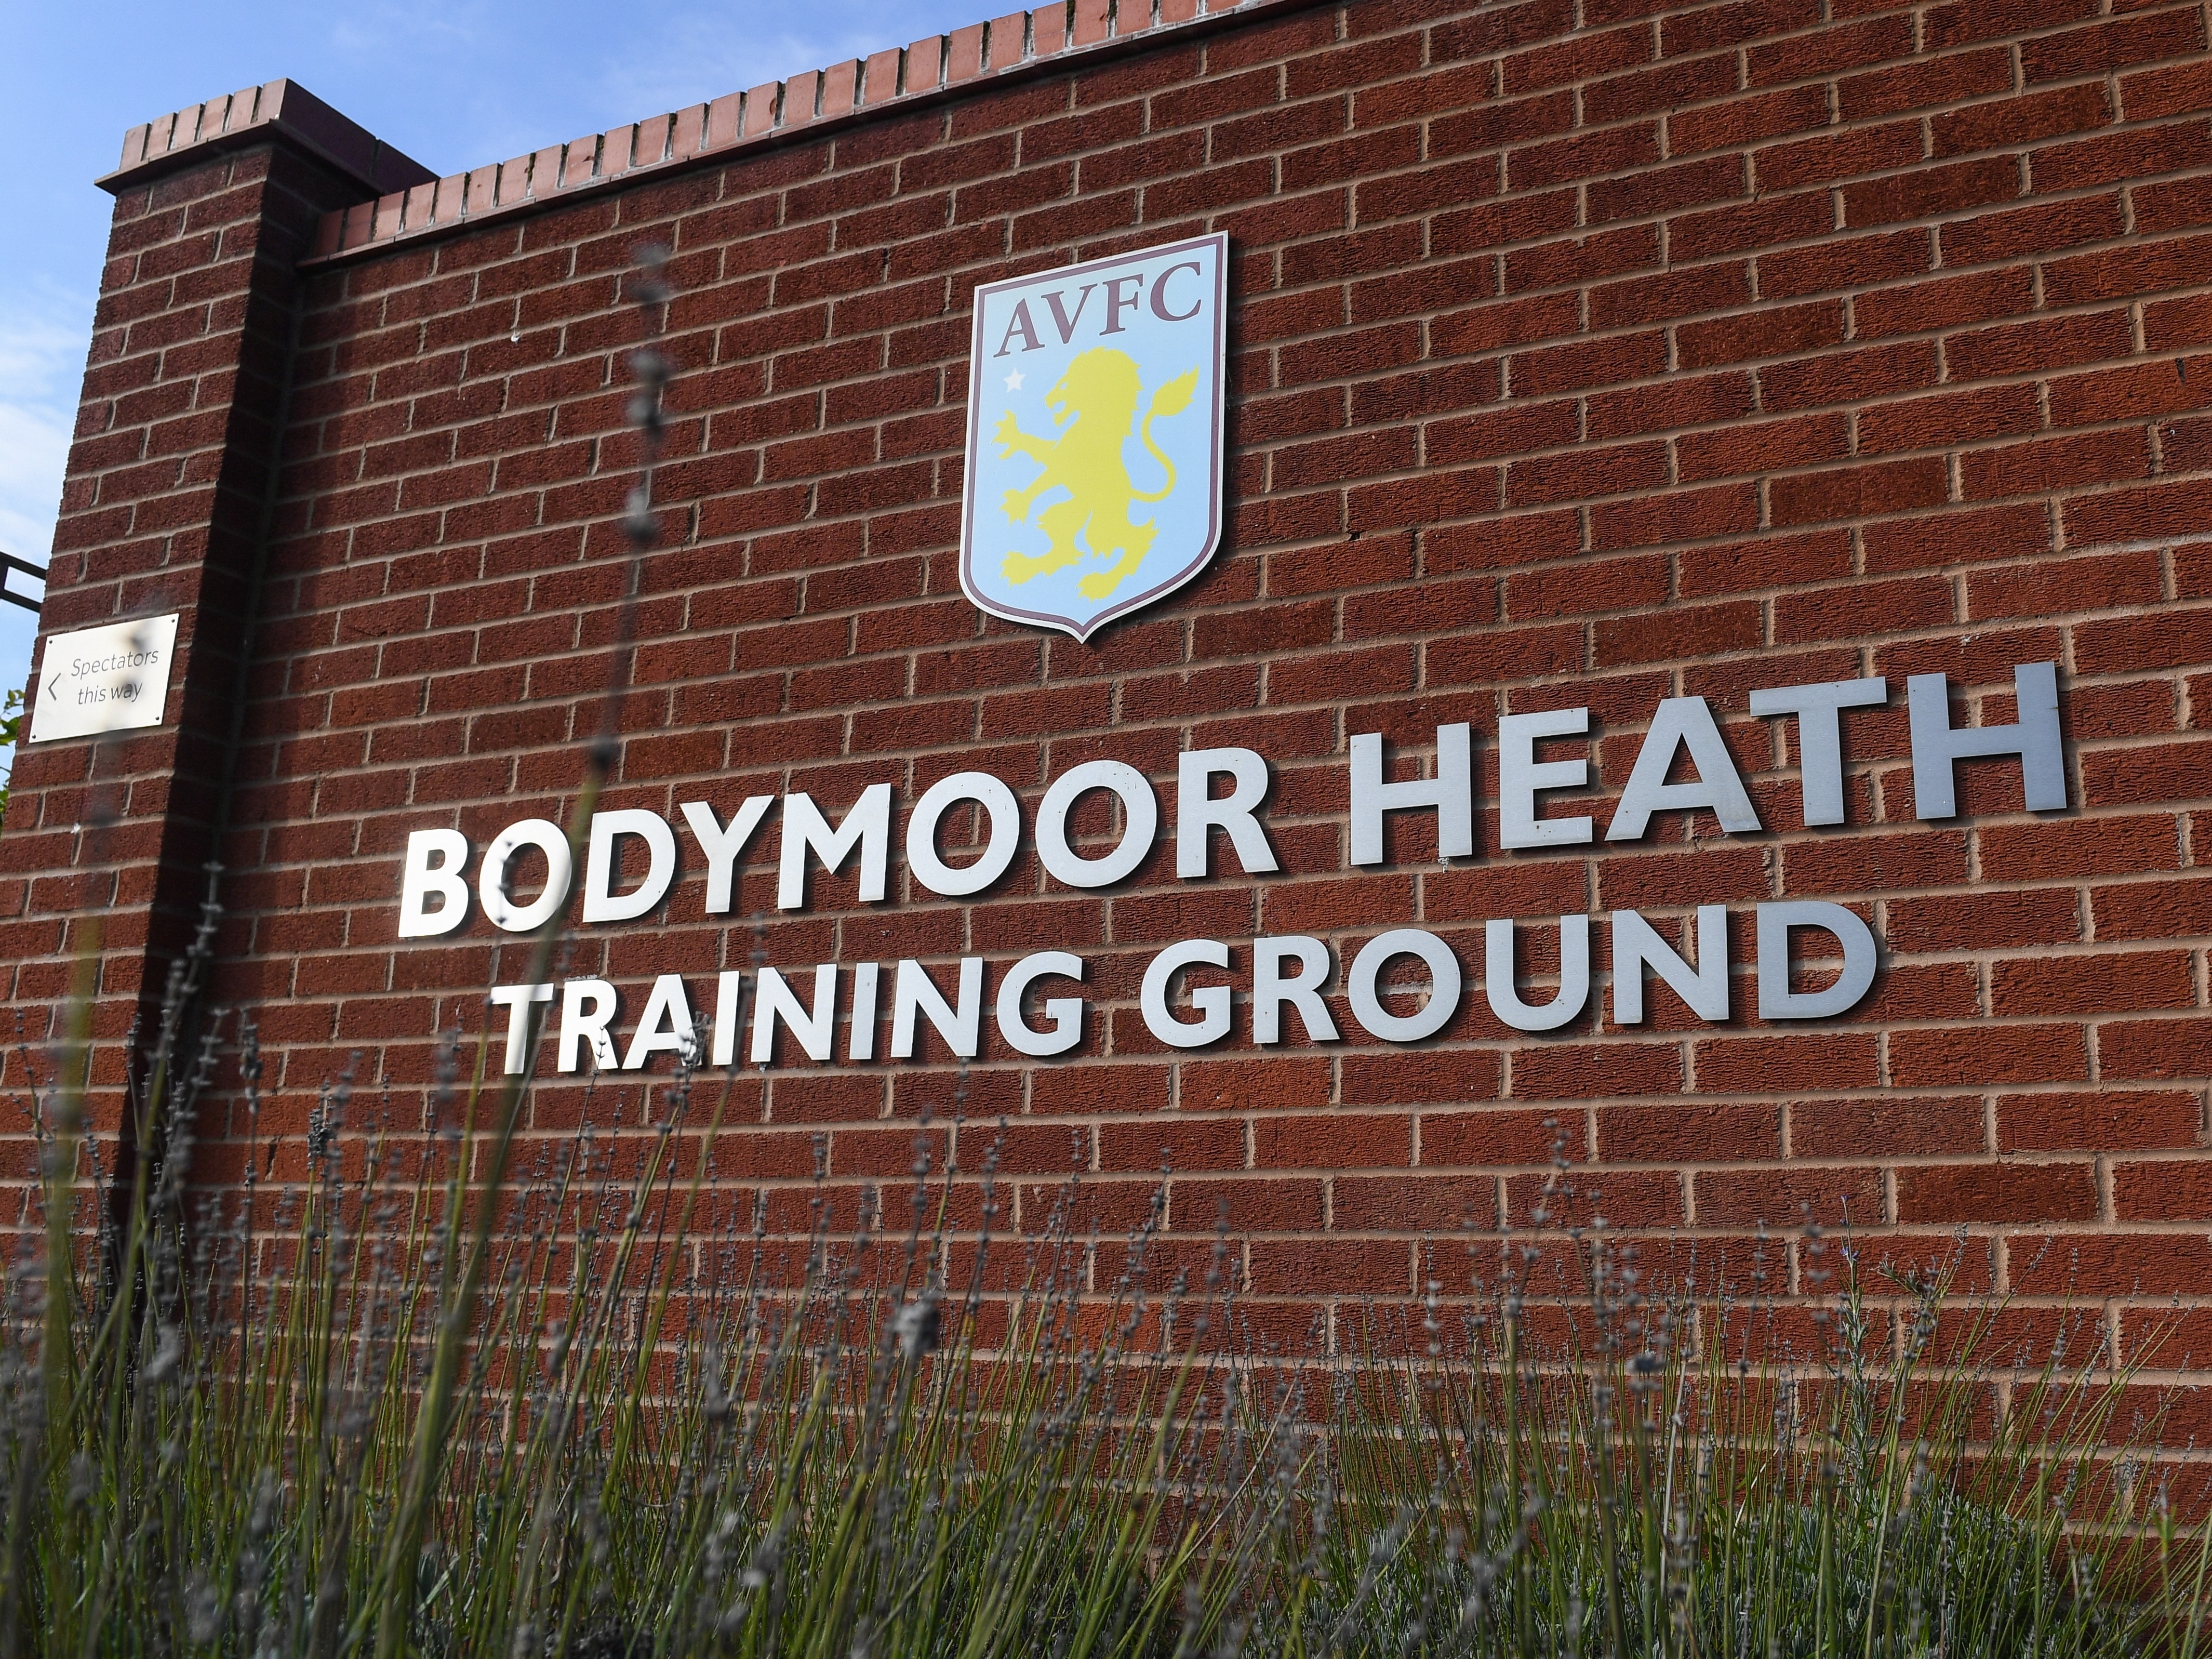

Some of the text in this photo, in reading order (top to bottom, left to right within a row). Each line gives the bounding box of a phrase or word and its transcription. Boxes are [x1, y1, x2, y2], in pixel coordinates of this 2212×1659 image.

[993, 261, 1202, 358] AVFC
[71, 649, 159, 680] Spectators
[78, 682, 143, 705] this way
[397, 661, 2067, 938] BODYMOOR HEATH
[490, 901, 1877, 1075] TRAINING GROUND
